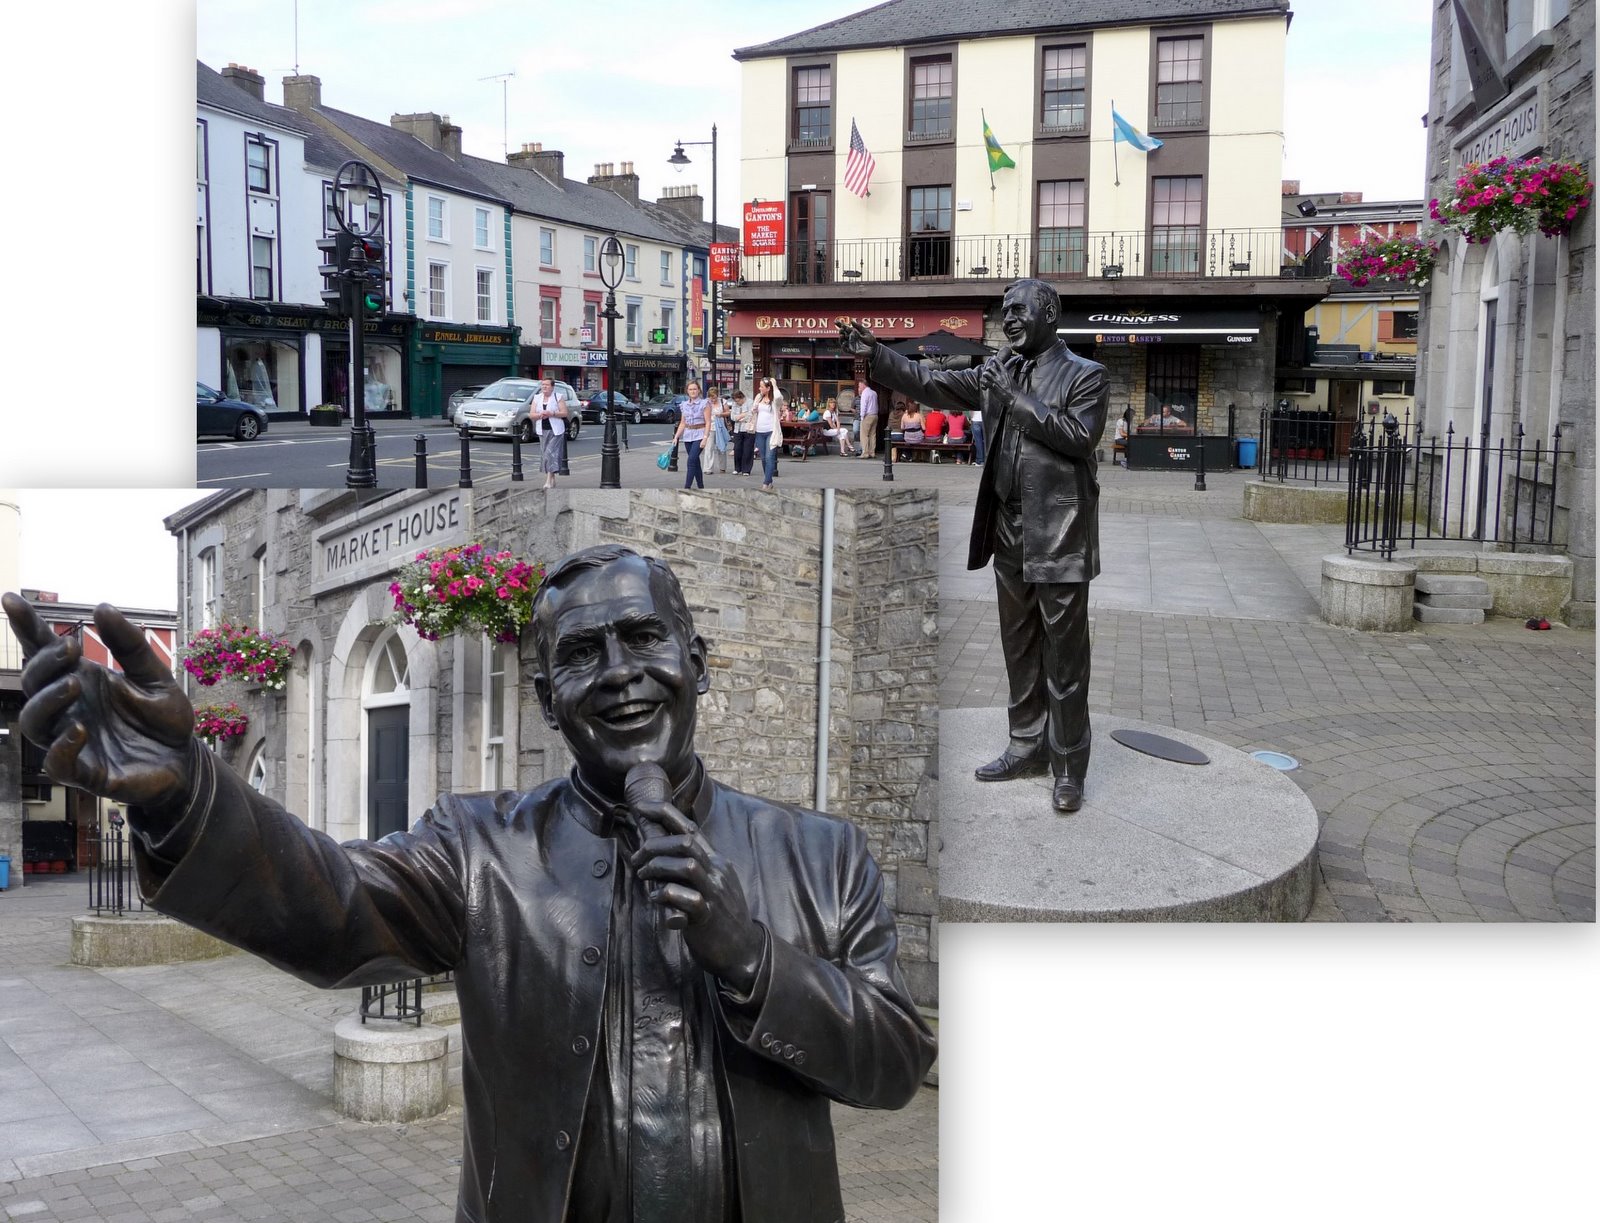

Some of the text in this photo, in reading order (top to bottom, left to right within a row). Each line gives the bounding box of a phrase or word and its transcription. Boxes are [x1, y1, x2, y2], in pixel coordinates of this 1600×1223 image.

[745, 212, 782, 222] CANTON'S
[752, 239, 776, 247] SQUARE
[277, 317, 308, 328] SHAW
[756, 315, 829, 330] CANTON
[1088, 314, 1180, 323] GUINNESS
[434, 331, 462, 341] ENNELL
[464, 333, 502, 344] JEWELLERS
[1095, 334, 1162, 343] CANTON CASEY'S
[1226, 335, 1253, 343] GUINNESS
[545, 352, 580, 362] TOP MODEL
[623, 359, 681, 369] WHELEHANS Pharmacy
[326, 496, 460, 573] MARKET HOUSE
